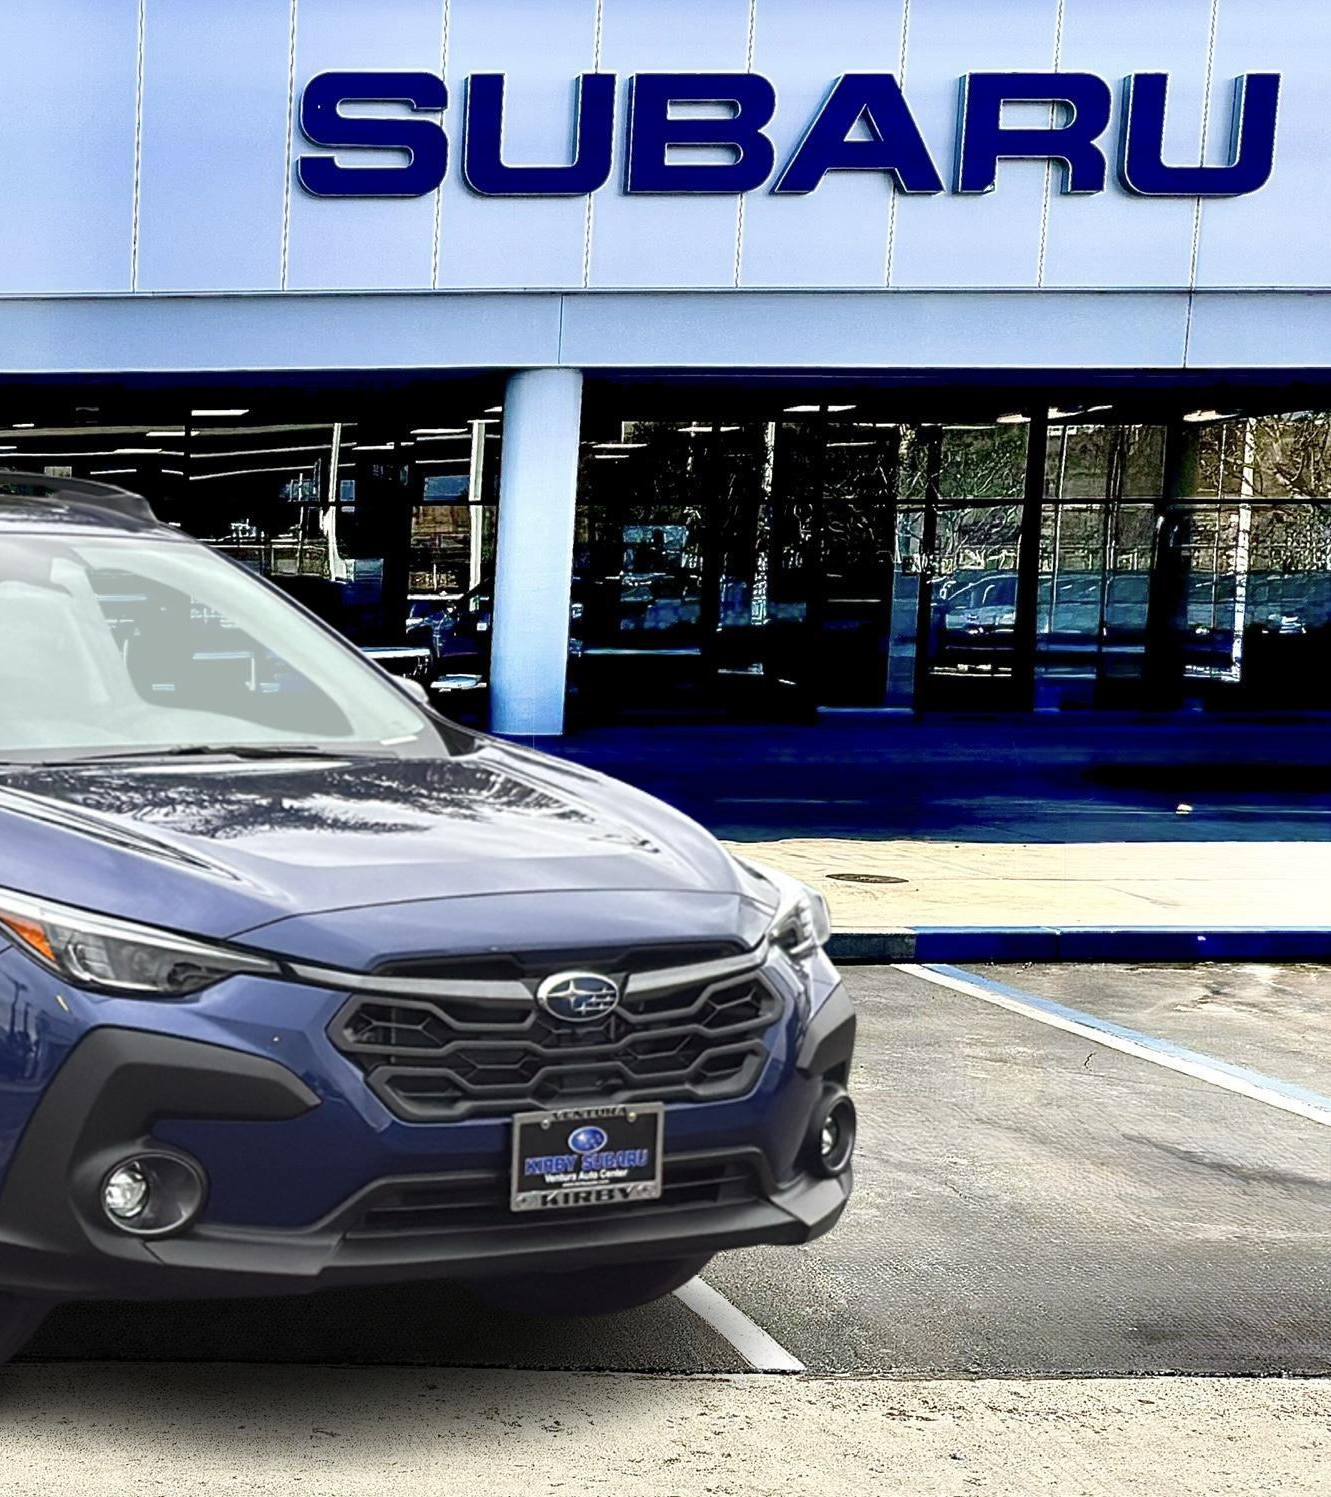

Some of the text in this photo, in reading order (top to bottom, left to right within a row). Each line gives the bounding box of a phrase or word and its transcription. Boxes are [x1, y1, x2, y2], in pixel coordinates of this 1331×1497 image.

[296, 70, 1282, 198] SUBARU
[552, 1107, 628, 1121] VENTURA
[525, 1149, 648, 1175] KIRBY SUBARU
[545, 1169, 628, 1183] Ventura Auto Center
[541, 1185, 633, 1206] KIRBY
